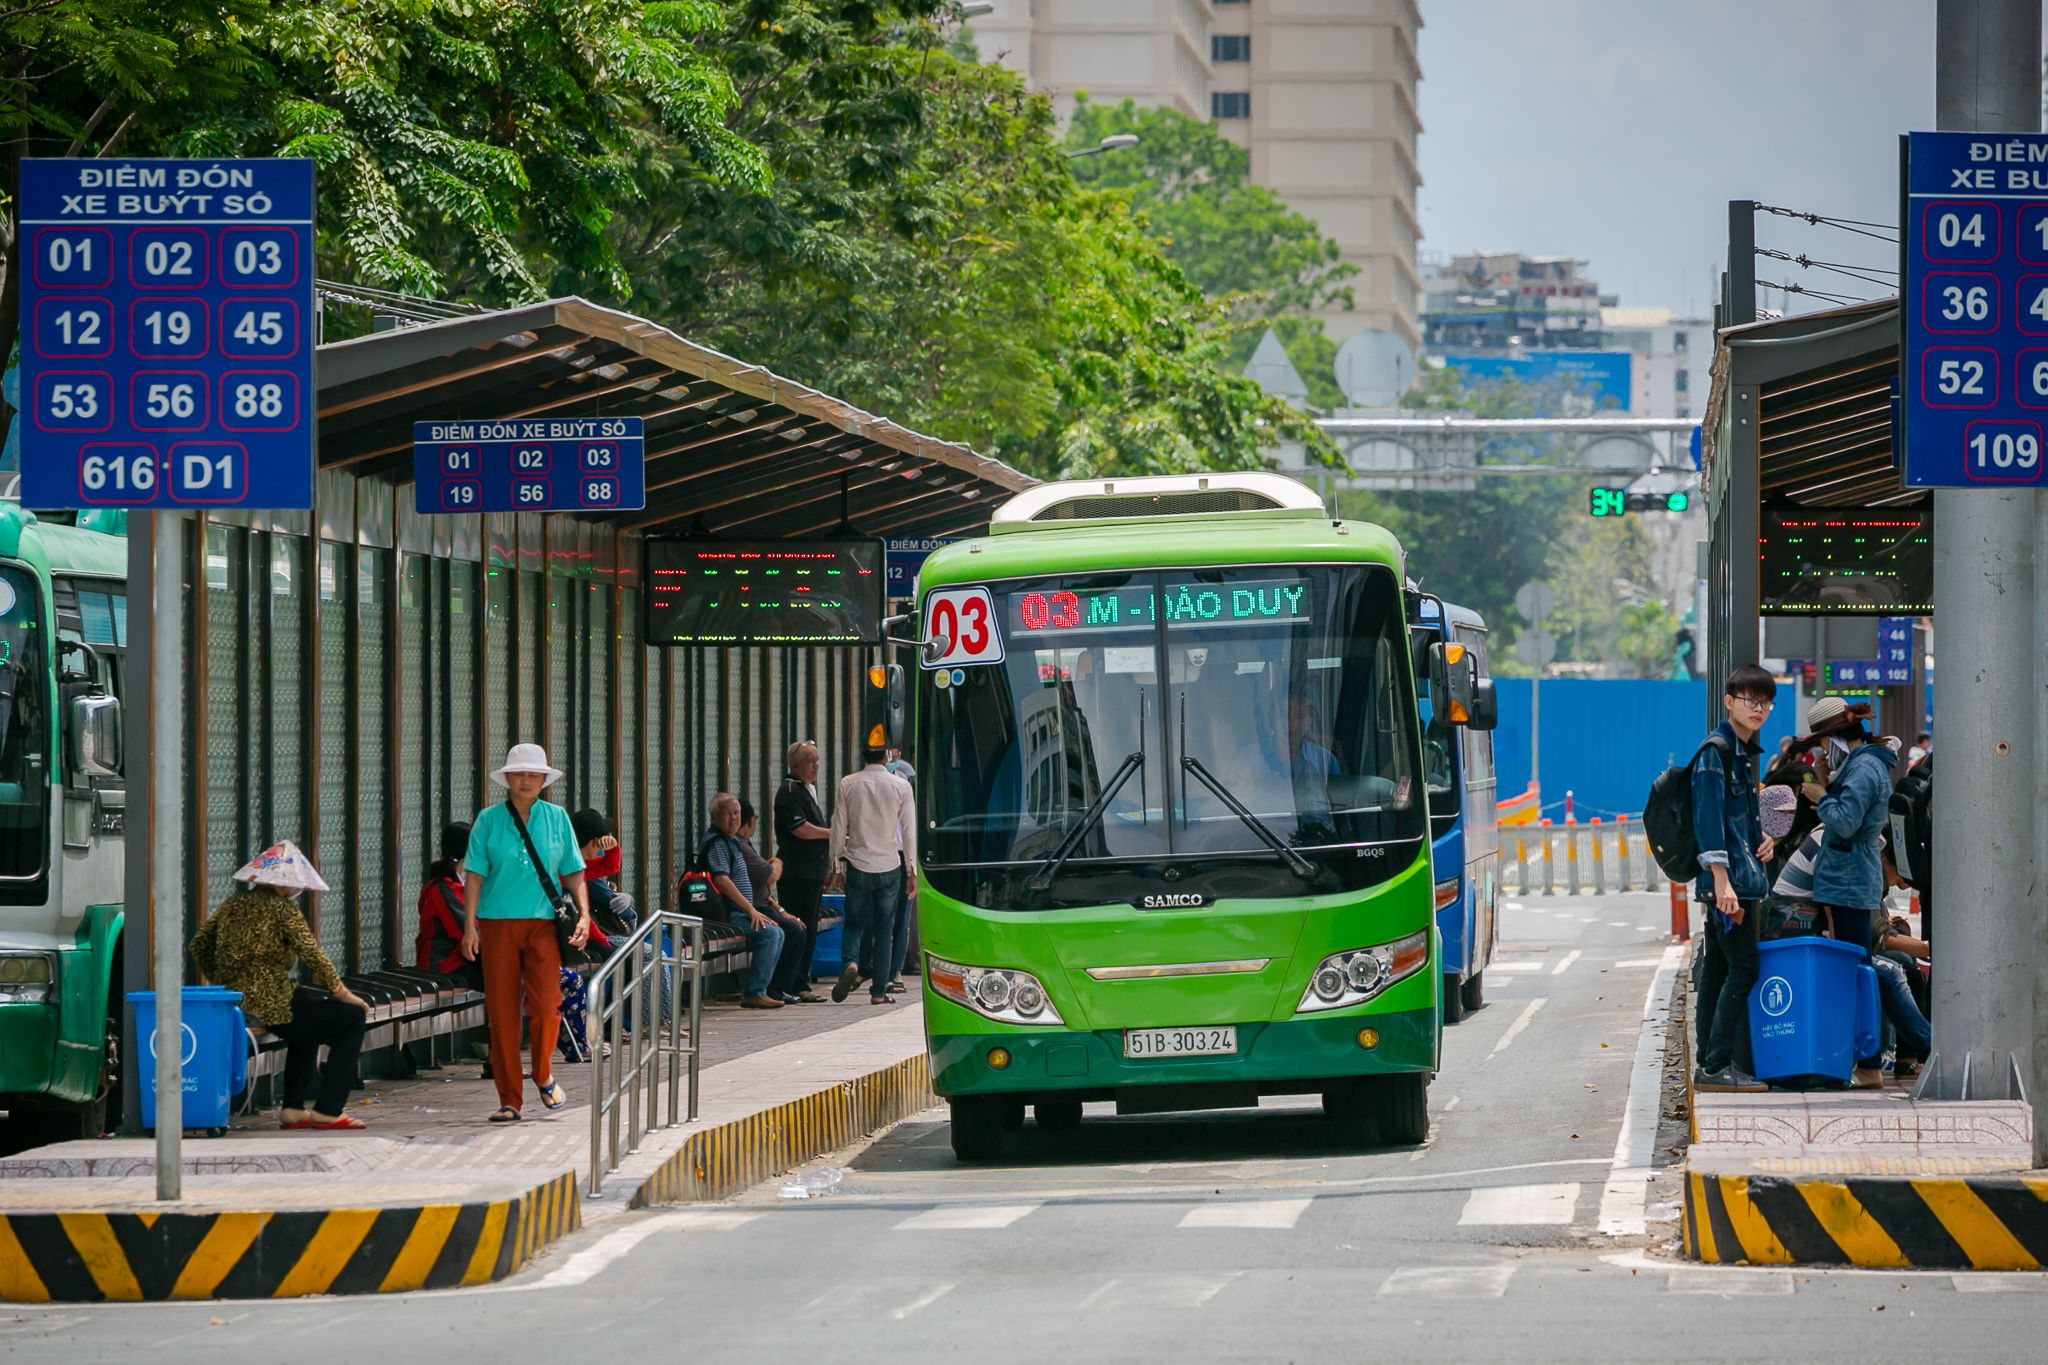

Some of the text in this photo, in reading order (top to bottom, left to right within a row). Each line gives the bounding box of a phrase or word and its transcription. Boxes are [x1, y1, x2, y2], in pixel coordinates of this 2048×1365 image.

[78, 164, 253, 188] ĐIỂM ĐÓN
[1950, 168, 1996, 189] XE
[60, 190, 273, 215] XE BUÝT SỐ
[1938, 213, 1985, 248] 04
[49, 238, 282, 275] 01 02 03
[1942, 286, 1989, 321] 36
[55, 311, 283, 345] 12 19 45
[1938, 360, 1984, 395] 52
[50, 383, 283, 419] 53 56 88
[479, 421, 517, 439] ĐÓN
[522, 423, 545, 438] XE
[550, 419, 597, 437] BUÝT
[601, 419, 626, 437] SỐ
[448, 448, 611, 469] 01 02 03
[1969, 433, 2038, 468] 109
[82, 455, 233, 490] 616 D1
[450, 483, 612, 504] 19 56 88
[1591, 488, 1624, 517] 34
[888, 567, 903, 579] 12
[1021, 591, 1080, 629] 03
[1232, 586, 1303, 617] DUY
[931, 596, 989, 658] 03
[1887, 669, 1908, 680] 102
[1356, 847, 1385, 858] BGQ5
[1144, 893, 1203, 908] SAMCO
[1131, 1030, 1233, 1054] 51B-303.24
